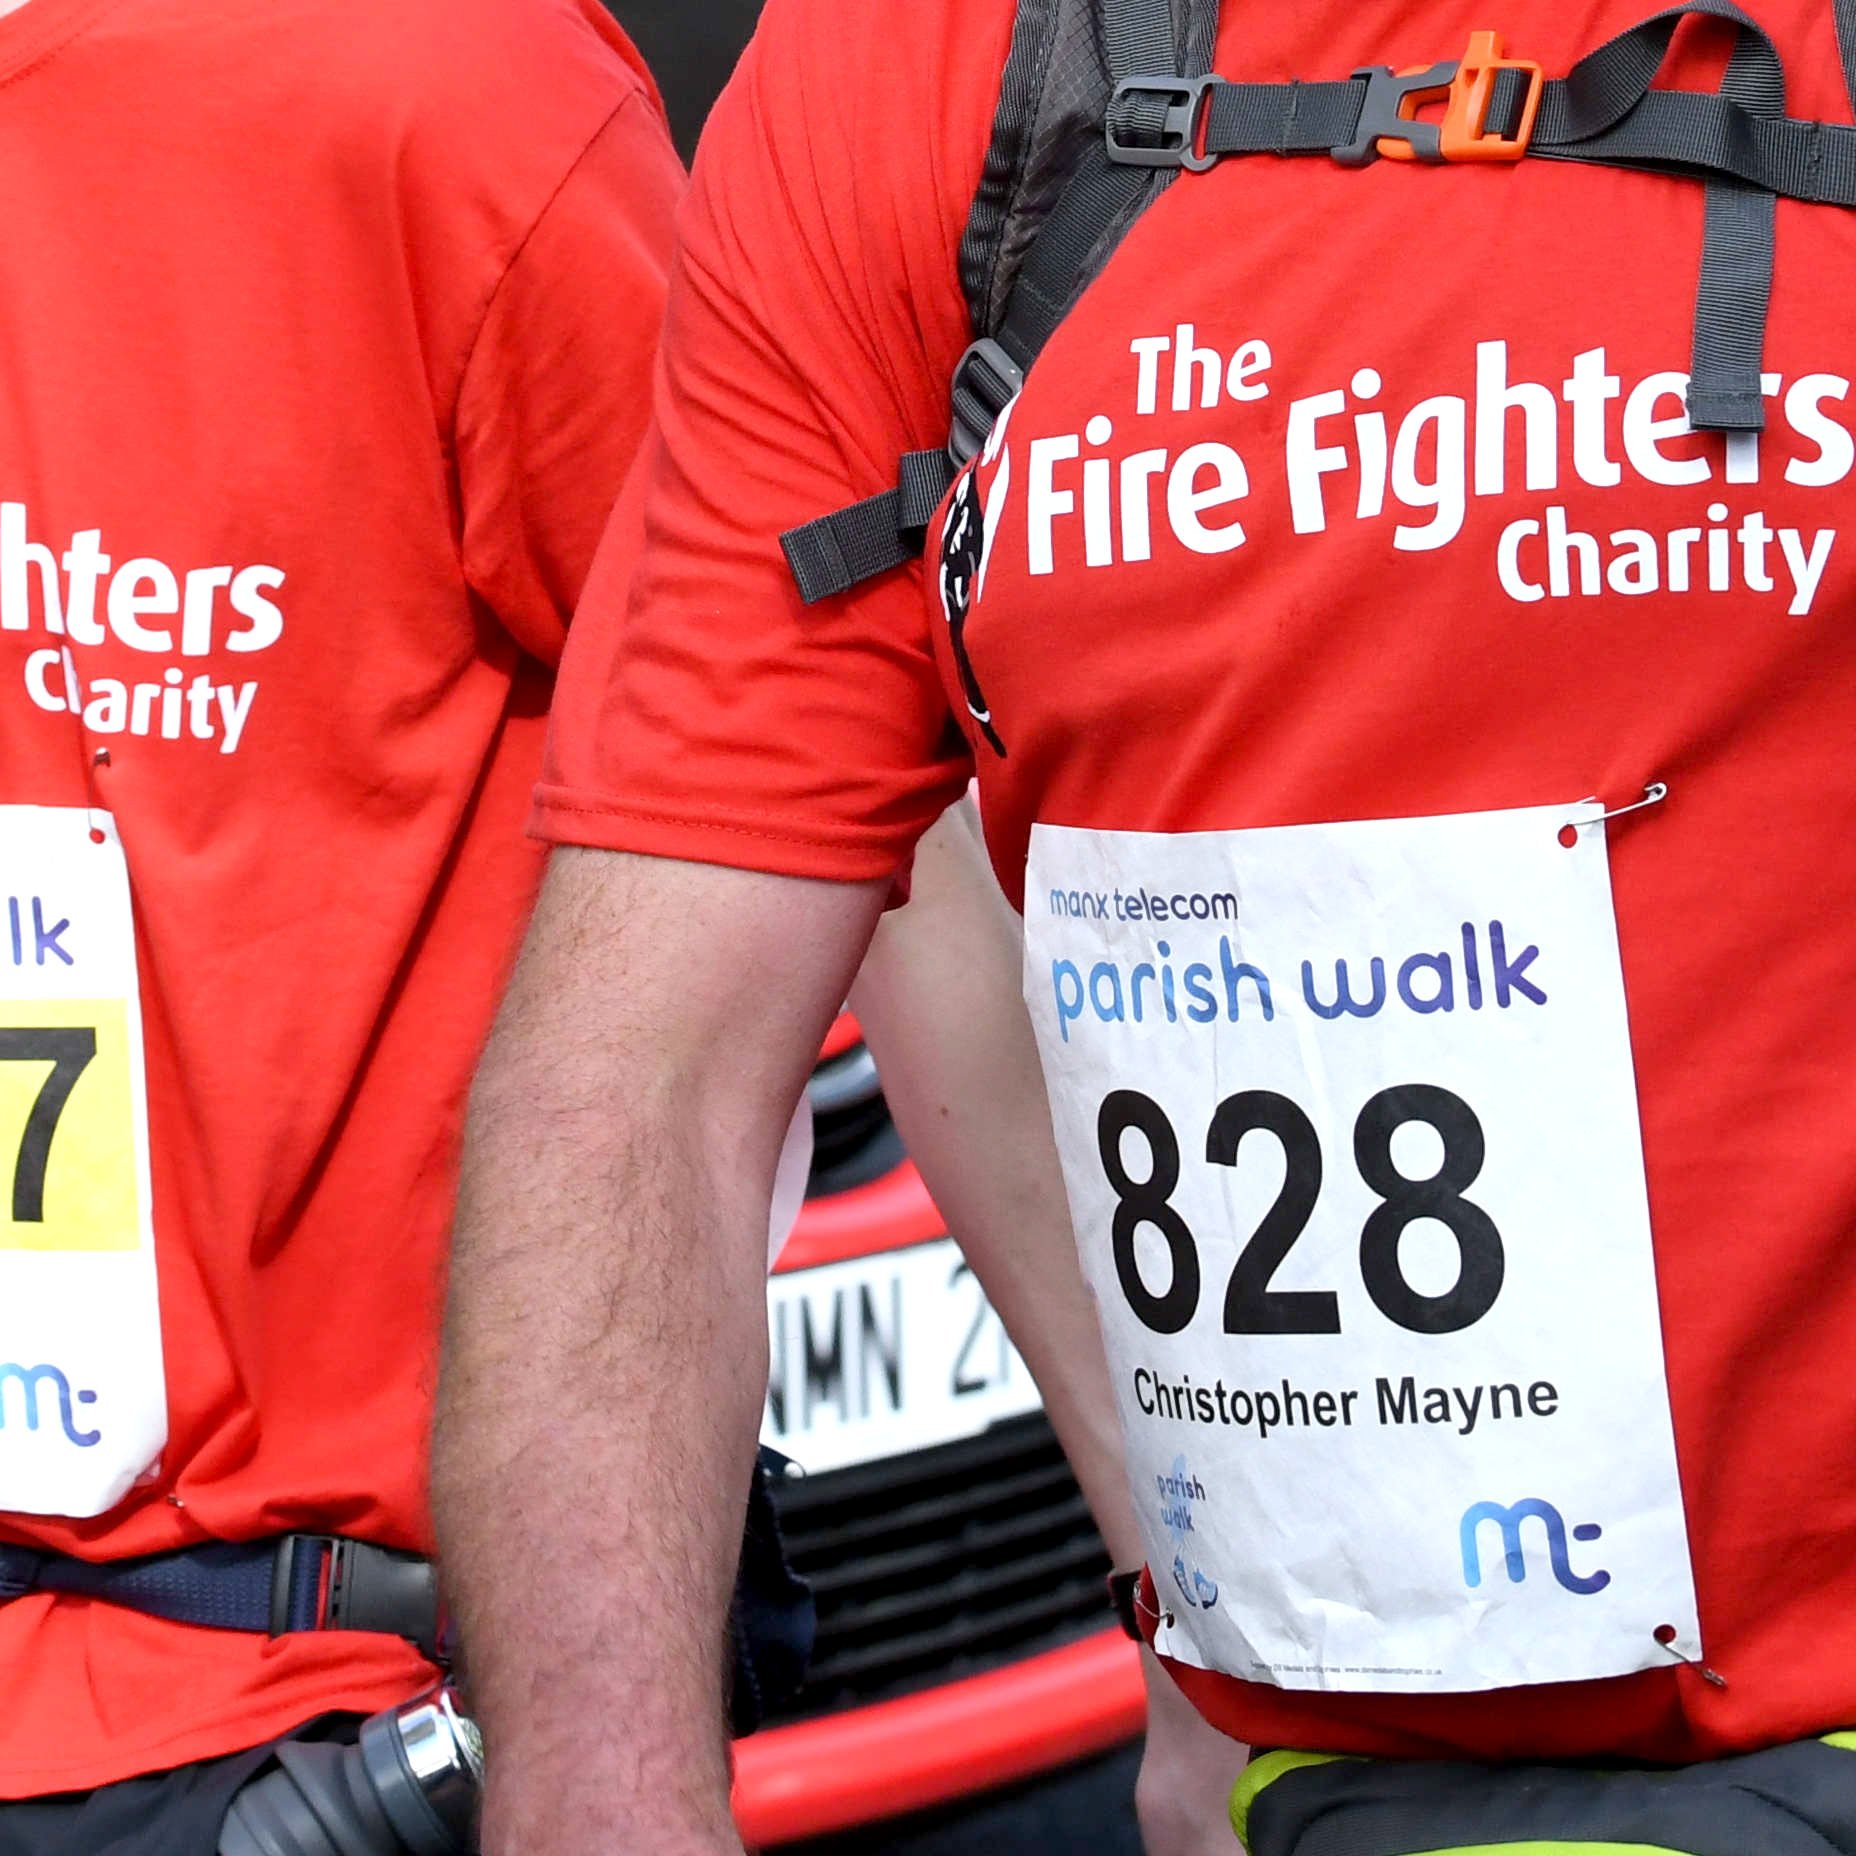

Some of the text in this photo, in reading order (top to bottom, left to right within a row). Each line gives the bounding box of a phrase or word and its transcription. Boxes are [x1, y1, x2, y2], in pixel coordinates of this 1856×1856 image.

[1130, 323, 1271, 415] The
[1028, 415, 1248, 576] Fire
[1496, 503, 1835, 616] Charity
[1050, 887, 1238, 921] manx telecom
[1051, 919, 1548, 1043] parish walk
[1097, 1083, 1505, 1335] 828
[1134, 1367, 1559, 1438] Christopher Mayne
[1156, 1472, 1206, 1501] parish
[1160, 1506, 1195, 1532] walk
